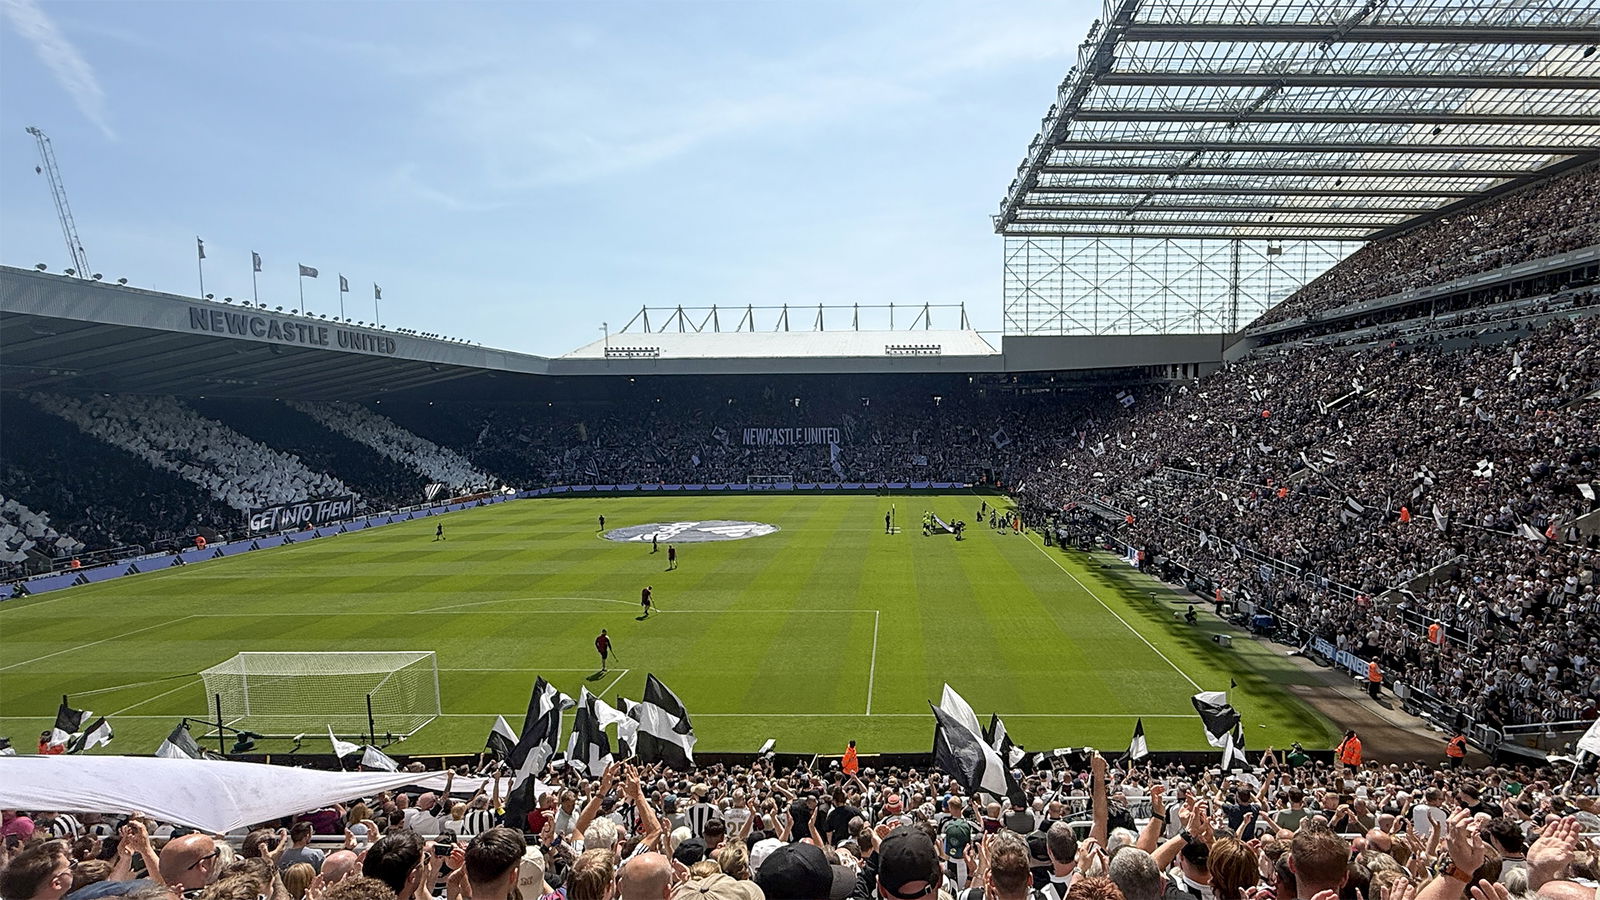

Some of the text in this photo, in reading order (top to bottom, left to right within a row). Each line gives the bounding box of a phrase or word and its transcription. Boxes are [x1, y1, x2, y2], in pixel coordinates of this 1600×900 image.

[189, 306, 397, 354] NEWCASTLE UNITED
[742, 427, 840, 445] NEWCASTLE UNITED
[250, 499, 352, 532] GET INTO THEM
